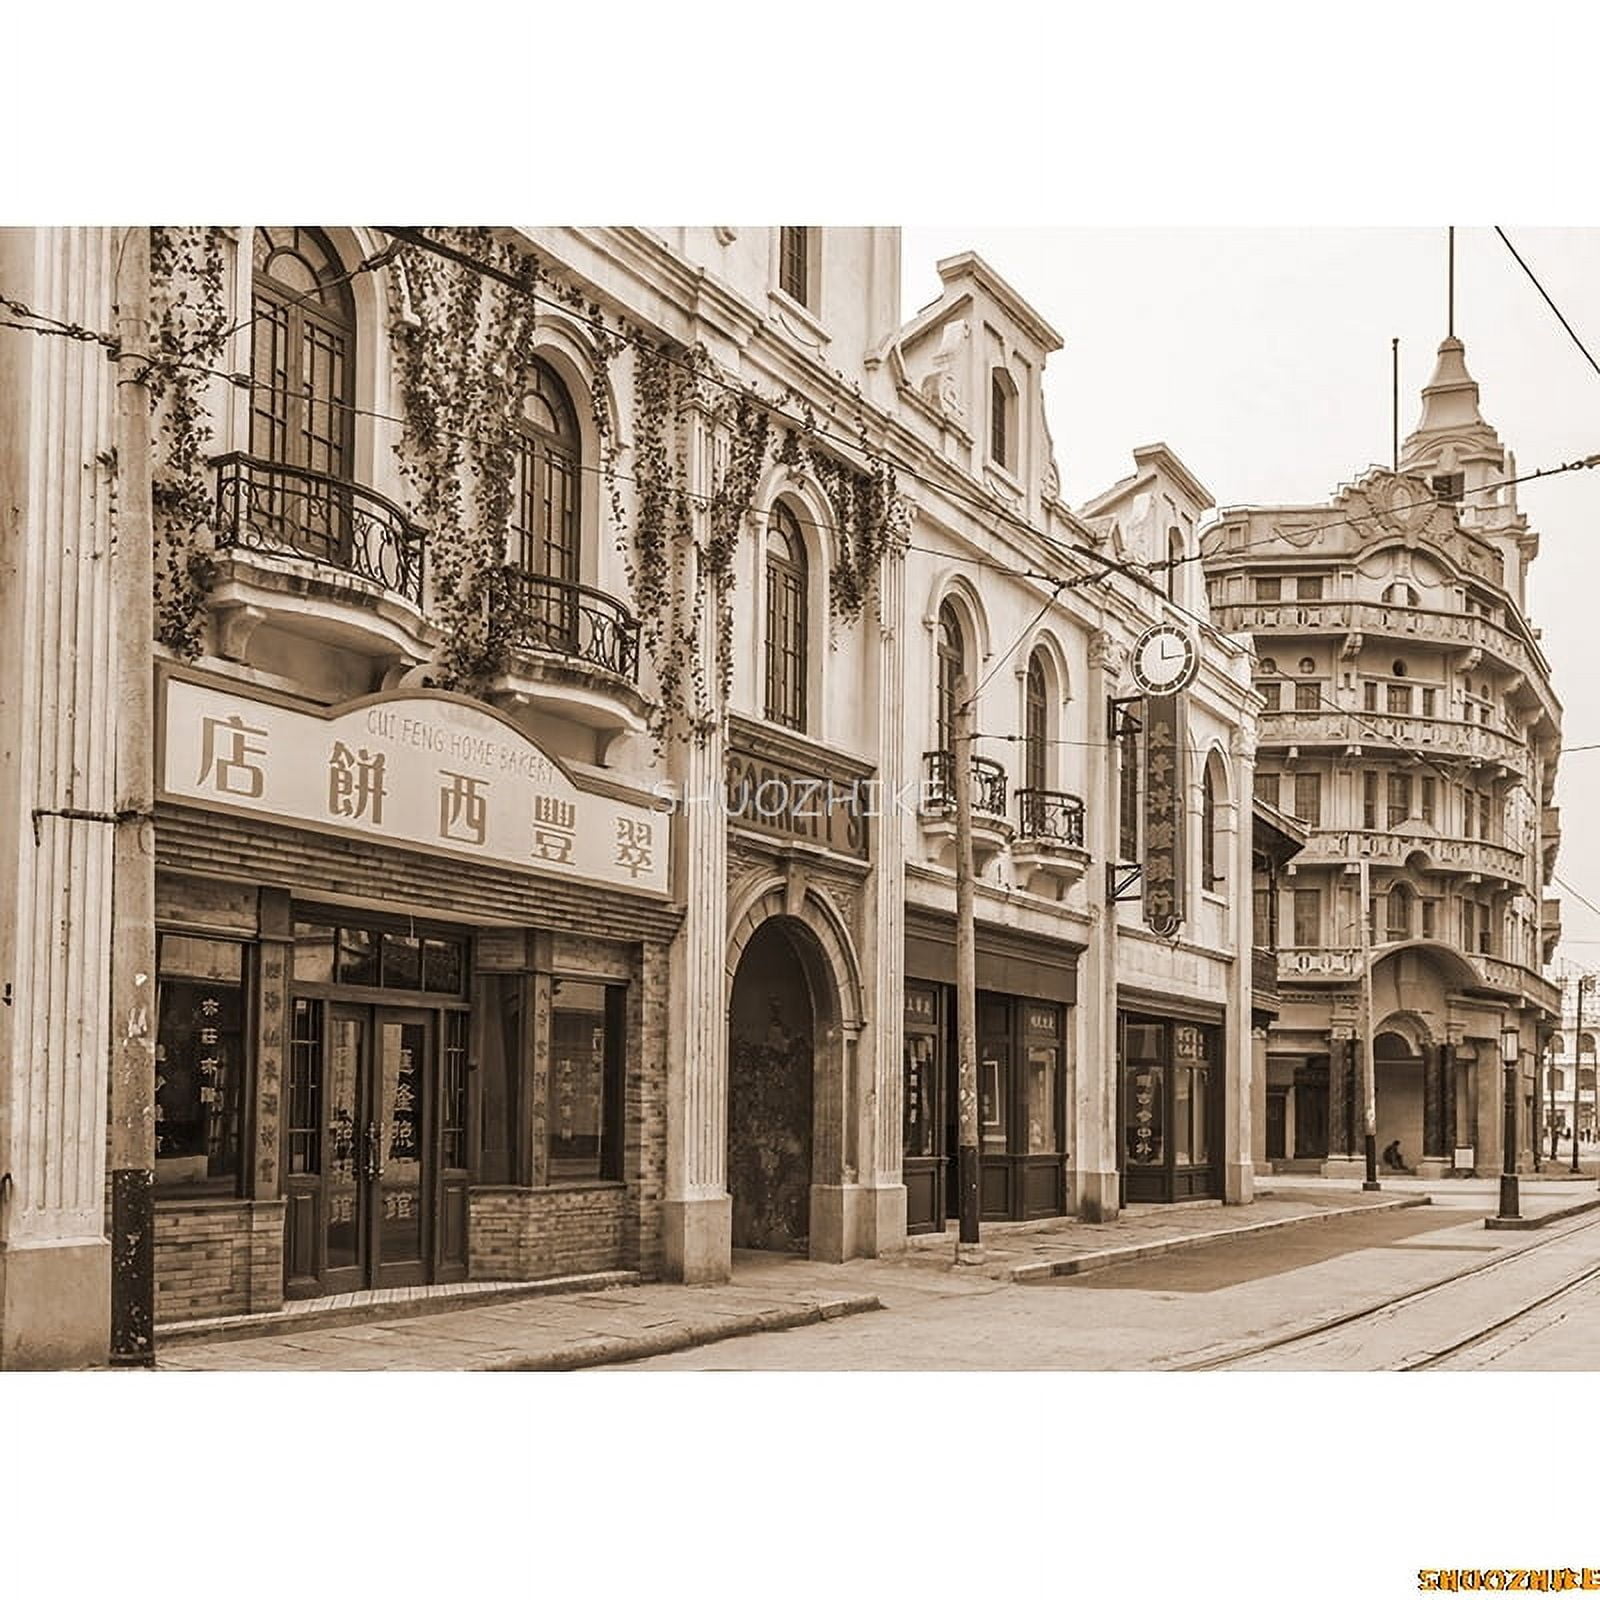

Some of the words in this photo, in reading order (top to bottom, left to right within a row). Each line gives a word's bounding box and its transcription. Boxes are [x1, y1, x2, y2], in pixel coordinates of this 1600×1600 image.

[367, 710, 396, 739] CUI
[402, 719, 445, 752] FENG
[450, 735, 496, 767] HOME
[499, 746, 555, 784] BAKERY
